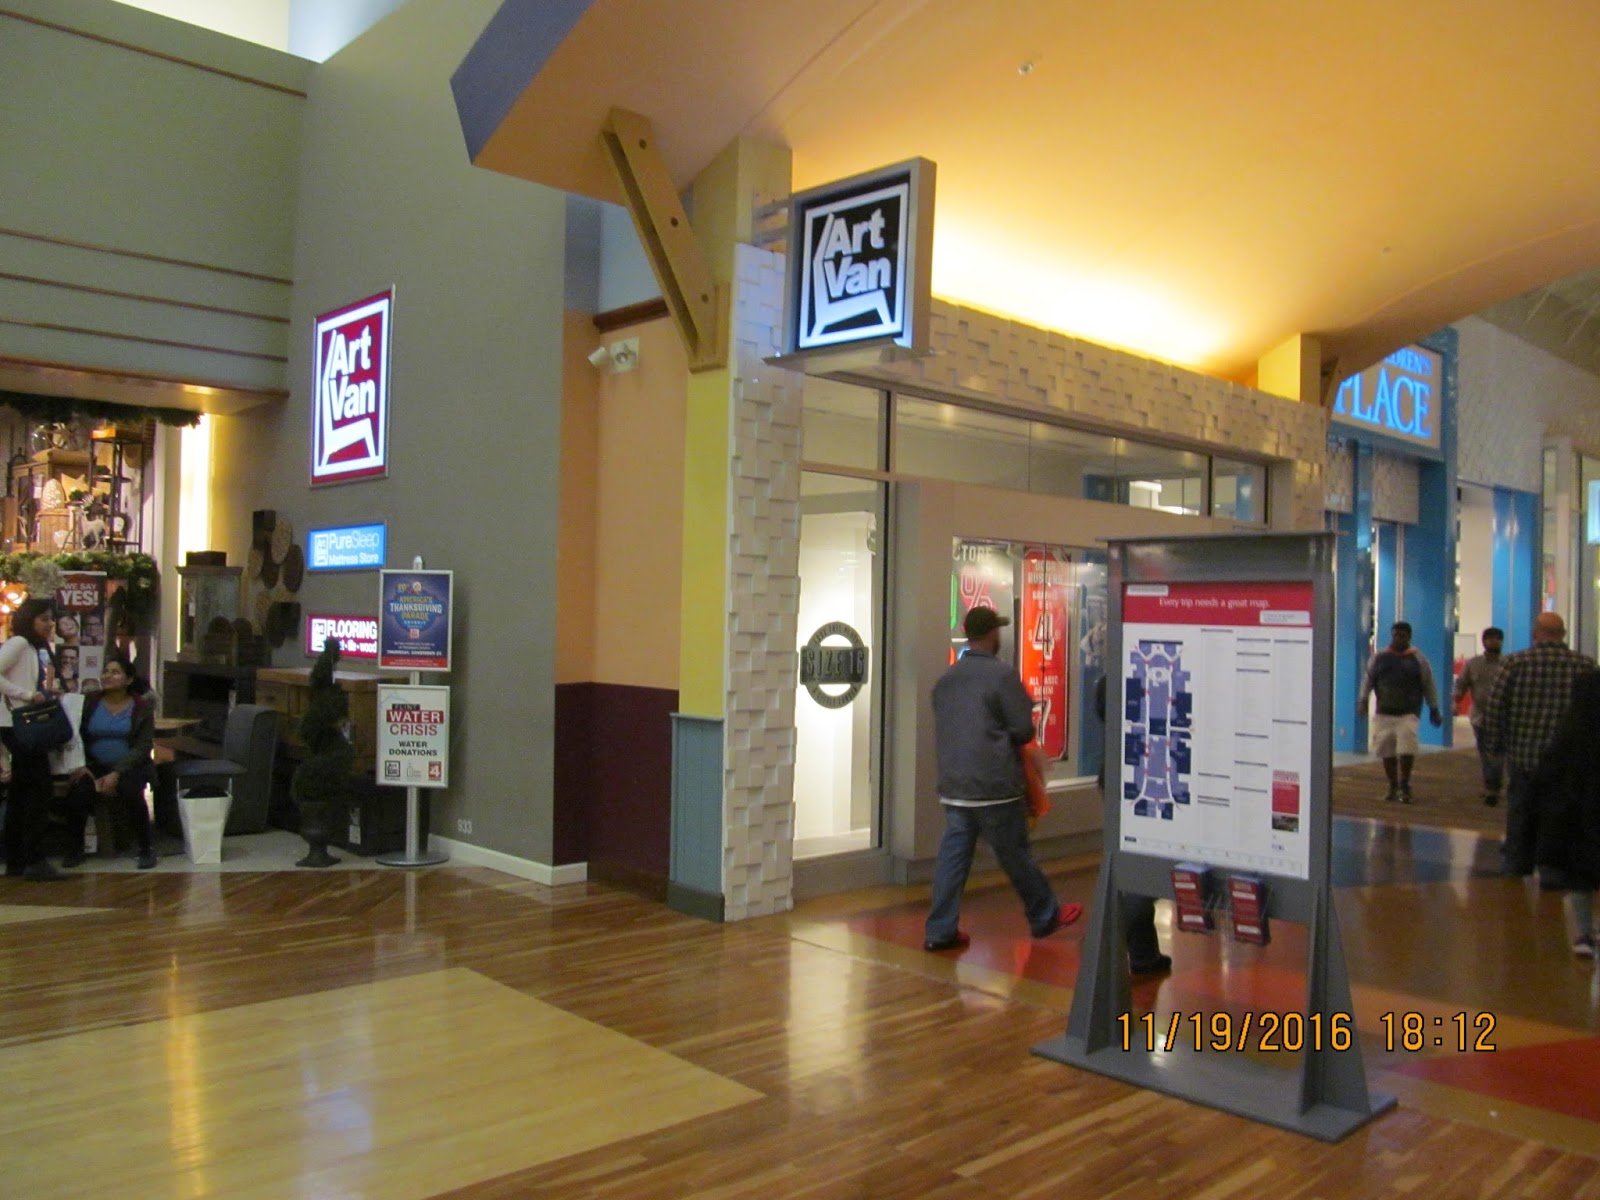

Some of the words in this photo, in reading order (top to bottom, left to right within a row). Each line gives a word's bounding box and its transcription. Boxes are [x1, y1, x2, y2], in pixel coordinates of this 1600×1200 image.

[824, 208, 885, 258] Art
[824, 256, 891, 298] Van
[330, 325, 371, 379] Art
[329, 375, 375, 421] Van
[329, 554, 359, 565] Mattress
[360, 552, 379, 563] Store
[60, 590, 99, 606] YES!
[389, 602, 442, 614] THANKSGIVING
[327, 620, 377, 640] FLOORING
[389, 710, 441, 723] WATER
[389, 724, 438, 736] CRISIS
[398, 740, 428, 748] WATER
[389, 749, 438, 757] DONATIONS
[429, 765, 440, 777] 4
